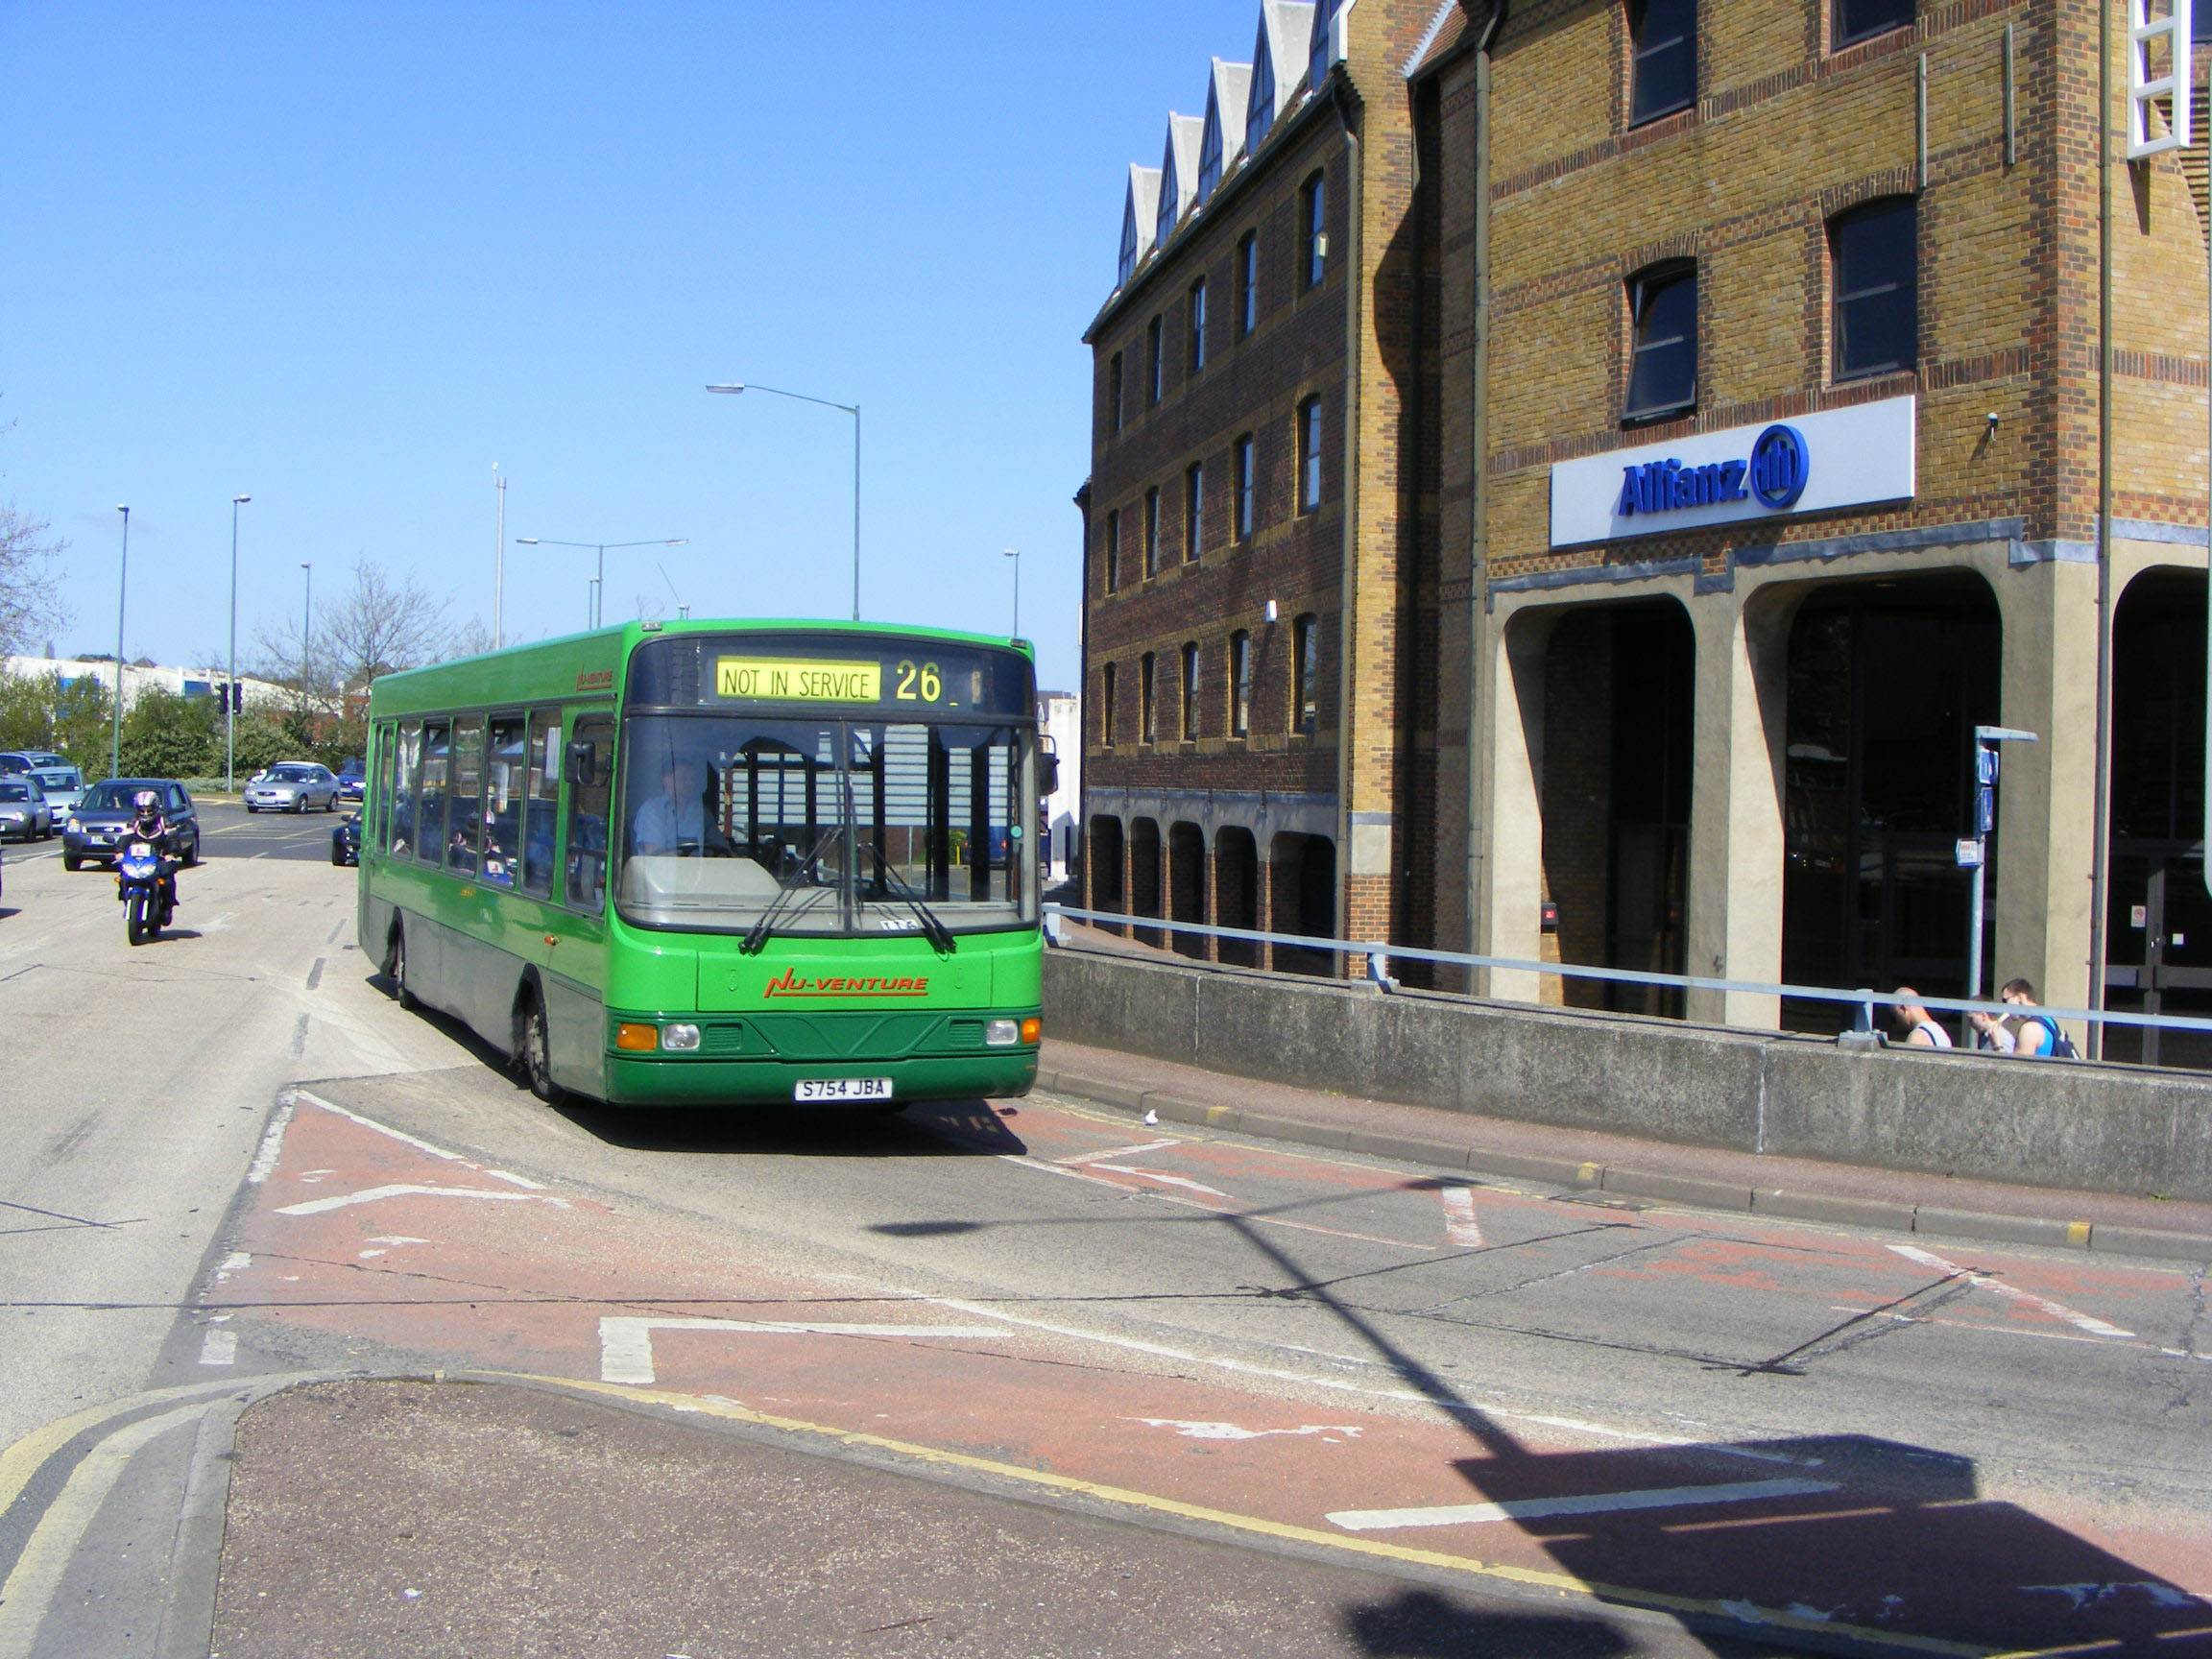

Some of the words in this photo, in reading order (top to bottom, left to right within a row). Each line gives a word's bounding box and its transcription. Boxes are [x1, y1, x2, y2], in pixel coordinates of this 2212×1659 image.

[1618, 458, 1749, 517] Allianz
[724, 669, 759, 695] NOT
[770, 670, 788, 696] IN
[799, 671, 870, 699] SERVICE
[896, 660, 942, 703] 26
[803, 1080, 847, 1096] S754
[853, 1078, 884, 1095] JBA
